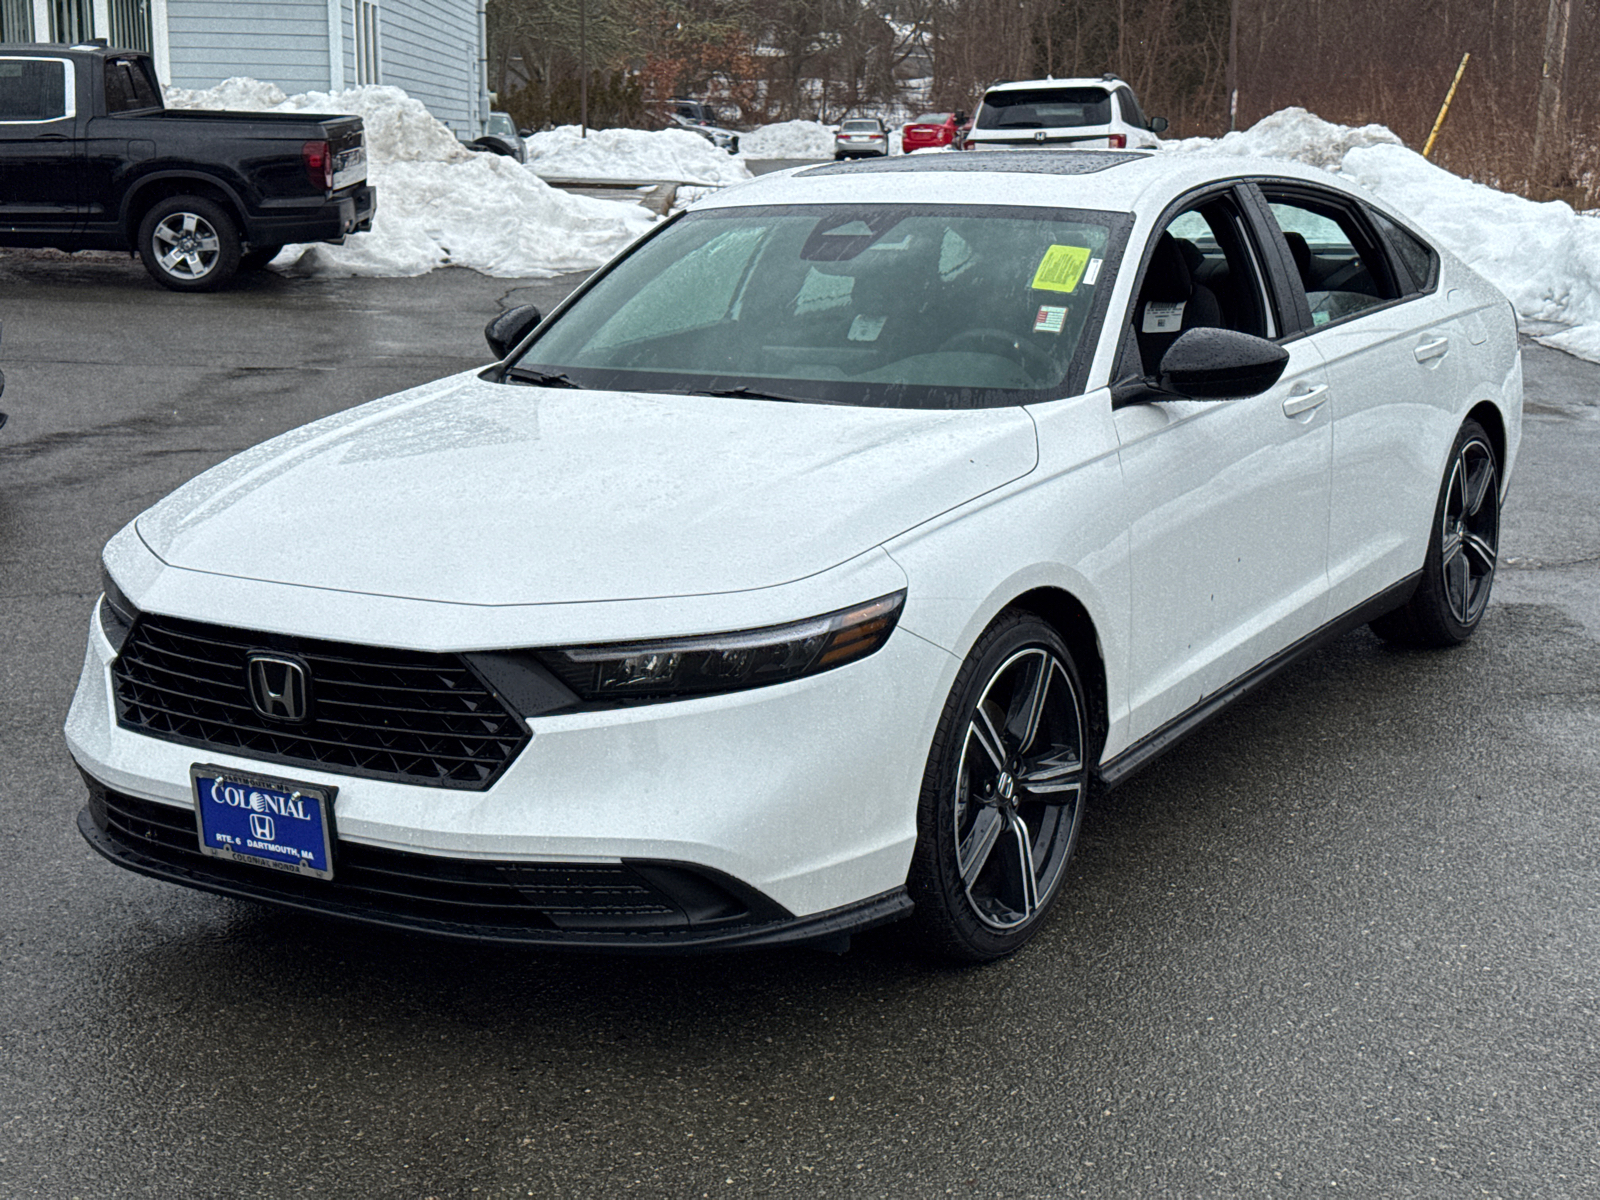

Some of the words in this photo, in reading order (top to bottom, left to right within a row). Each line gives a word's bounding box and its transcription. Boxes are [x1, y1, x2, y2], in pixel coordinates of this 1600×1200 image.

[211, 783, 311, 821] COLONIAL
[235, 837, 242, 845] 6
[246, 839, 300, 858] DARTMOUTH,
[300, 849, 315, 860] MA
[232, 852, 271, 868] COLONIAL
[272, 862, 301, 874] HONDA
